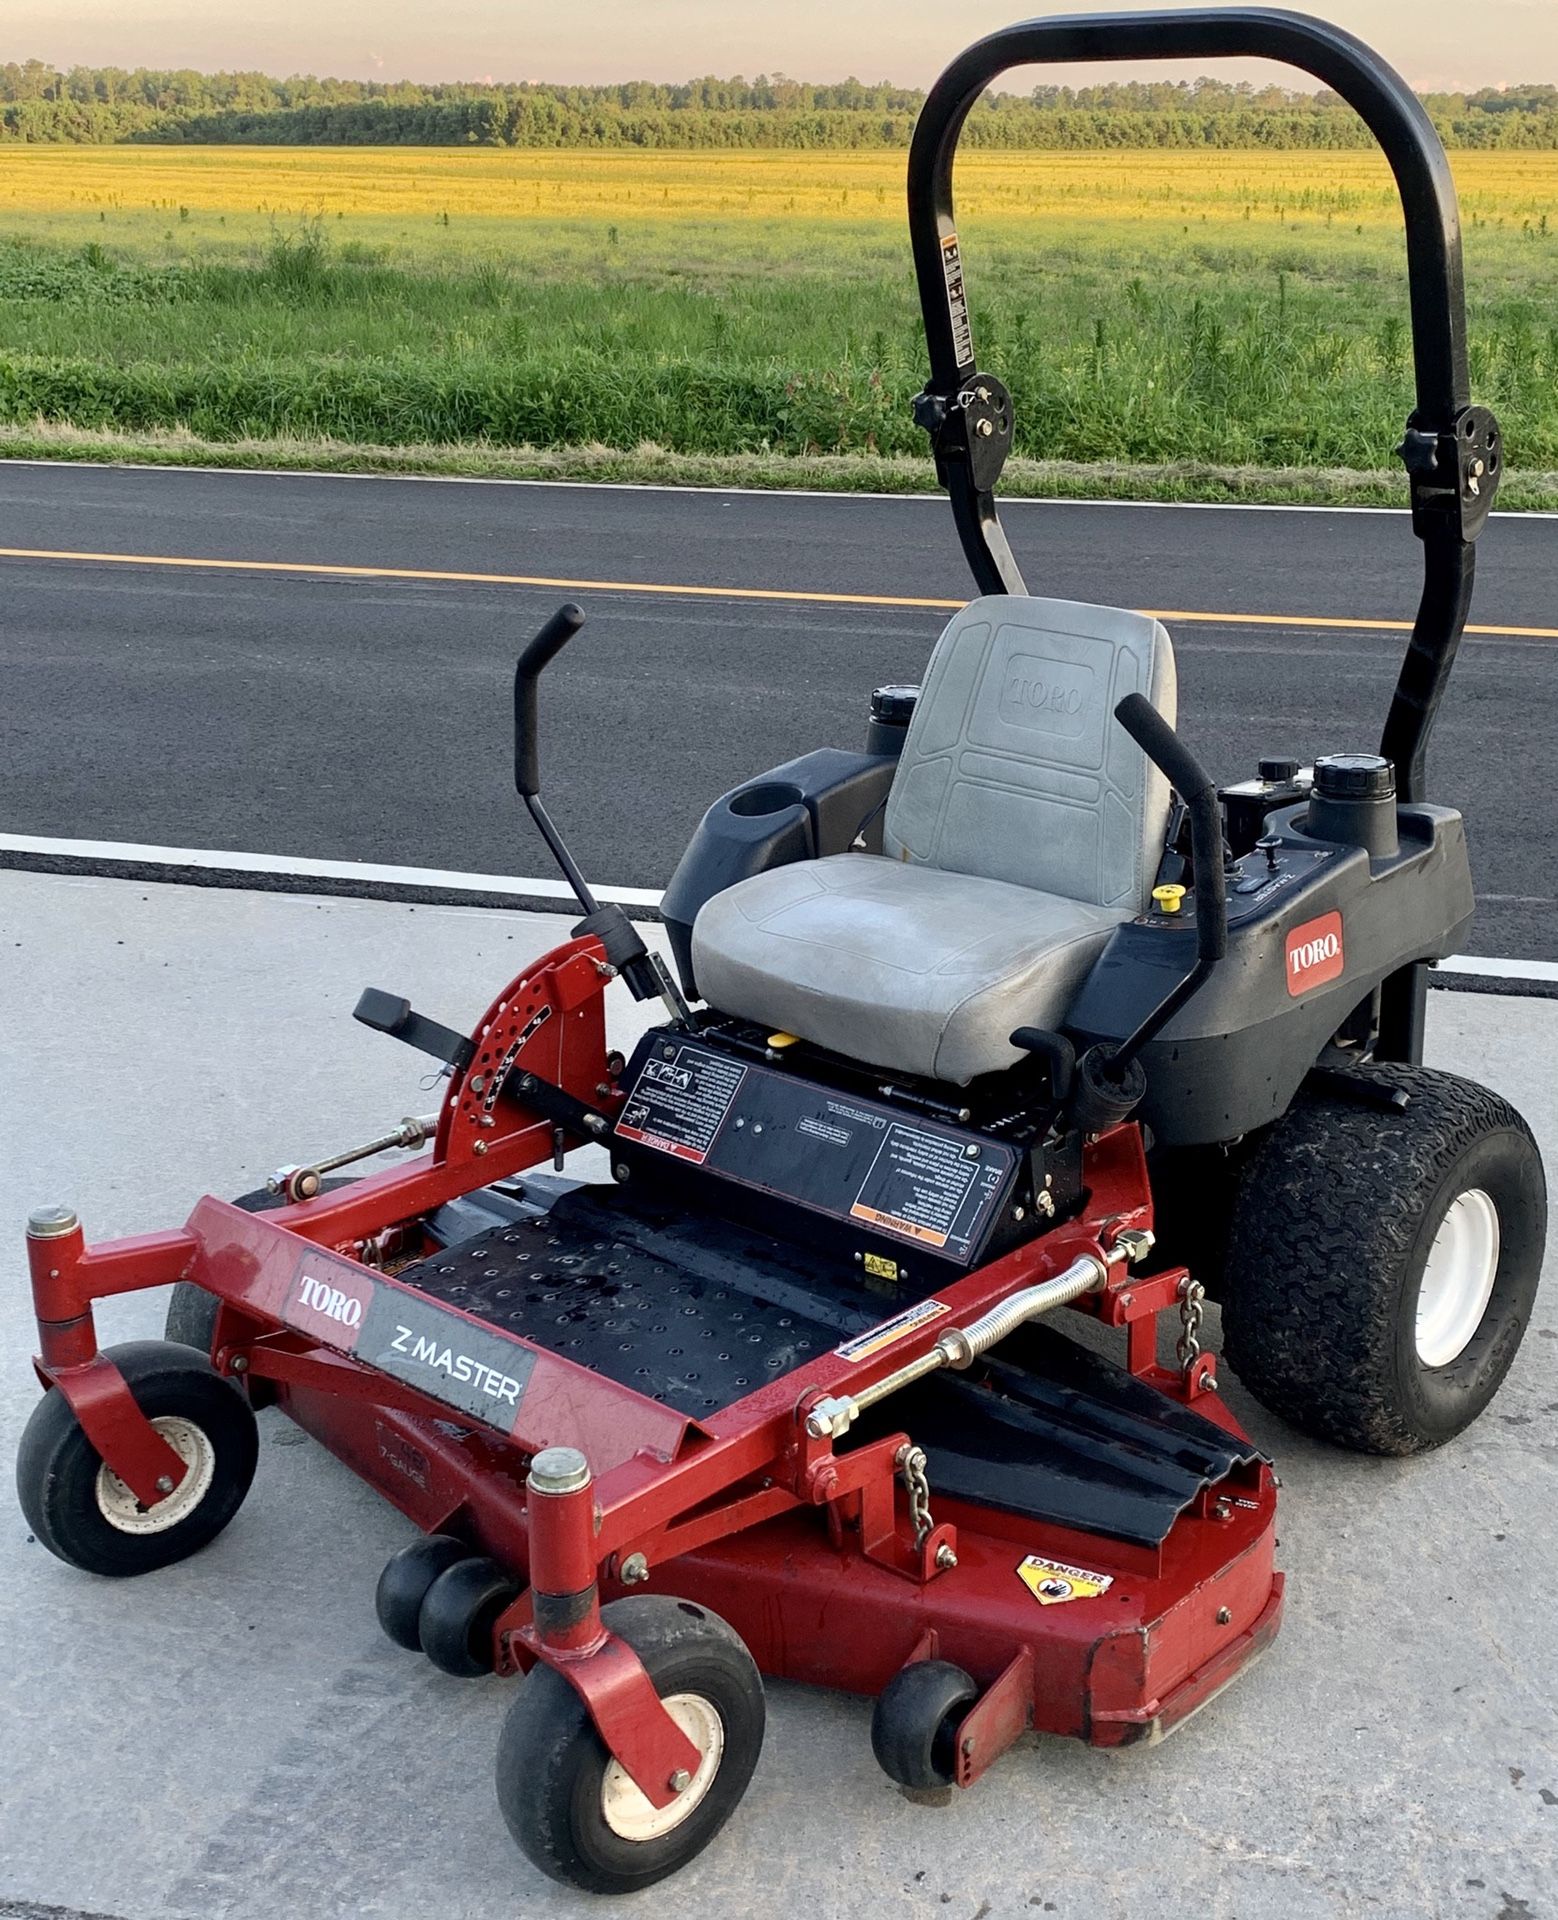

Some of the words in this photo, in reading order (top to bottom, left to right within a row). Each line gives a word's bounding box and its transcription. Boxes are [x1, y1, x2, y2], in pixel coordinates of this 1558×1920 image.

[1010, 678, 1082, 715] TORO
[1290, 933, 1339, 974] TORO
[641, 1133, 670, 1150] DANGER
[874, 1213, 912, 1233] WARNING
[298, 1275, 361, 1329] TORO
[391, 1325, 413, 1352] Z
[411, 1337, 521, 1405] MASTER
[1031, 1558, 1105, 1583] DANGER
